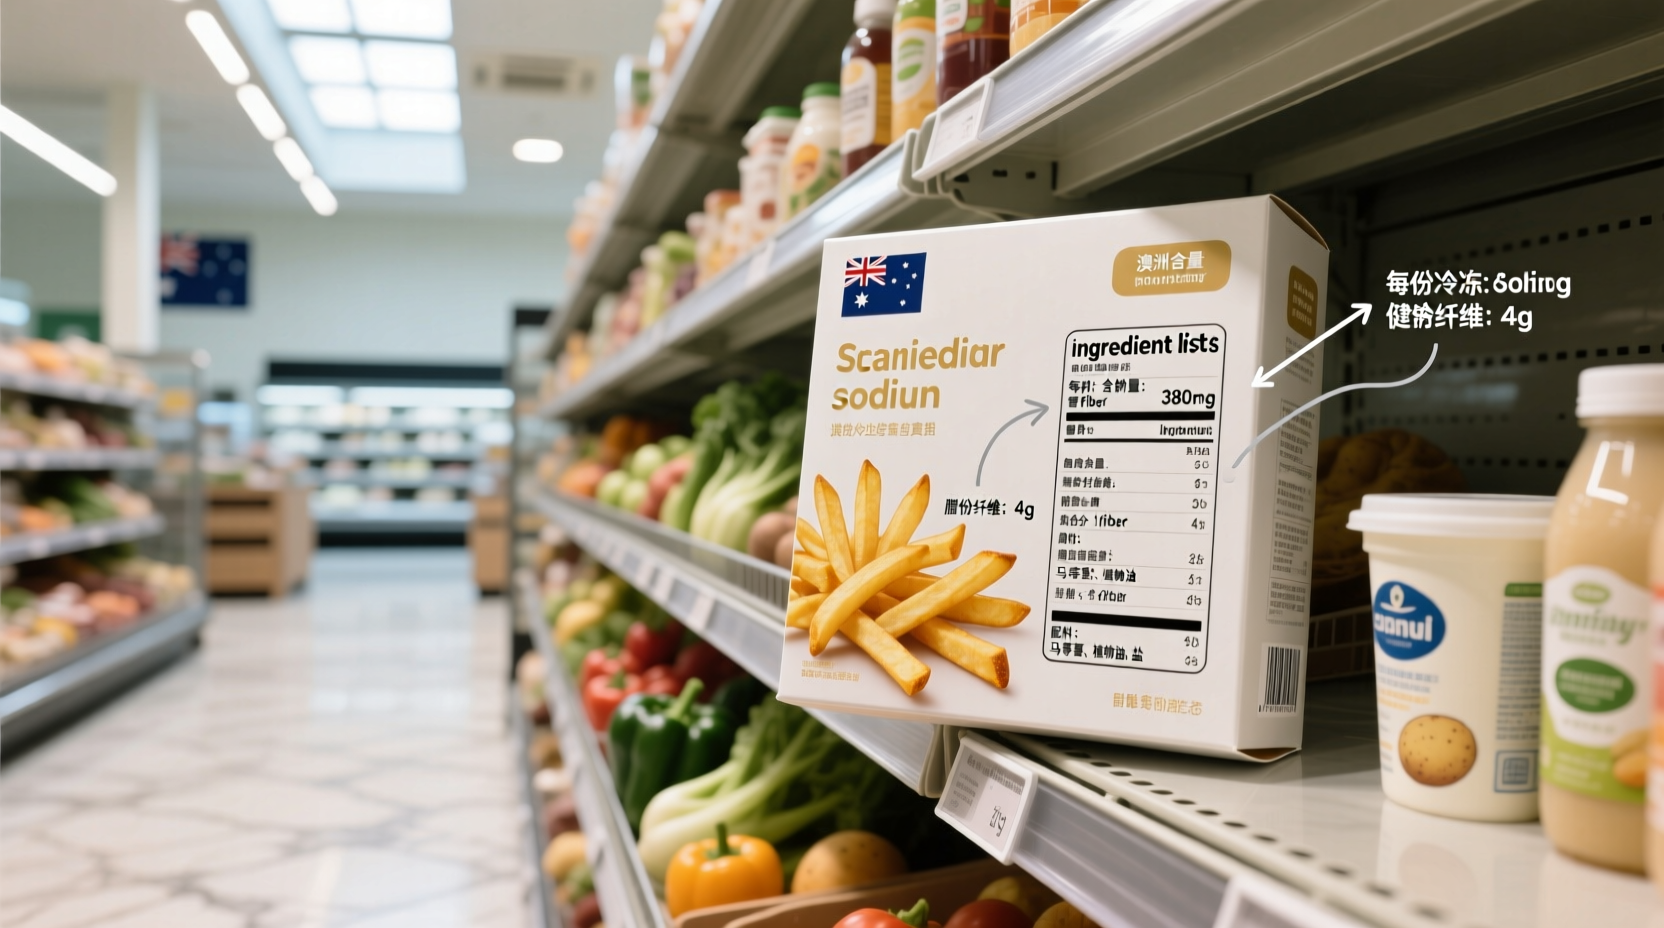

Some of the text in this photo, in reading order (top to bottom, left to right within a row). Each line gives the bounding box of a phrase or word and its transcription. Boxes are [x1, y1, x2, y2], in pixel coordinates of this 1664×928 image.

[1071, 332, 1219, 362] ingredient lists
[831, 378, 940, 410] sodiun
[1014, 500, 1035, 521] 4g
